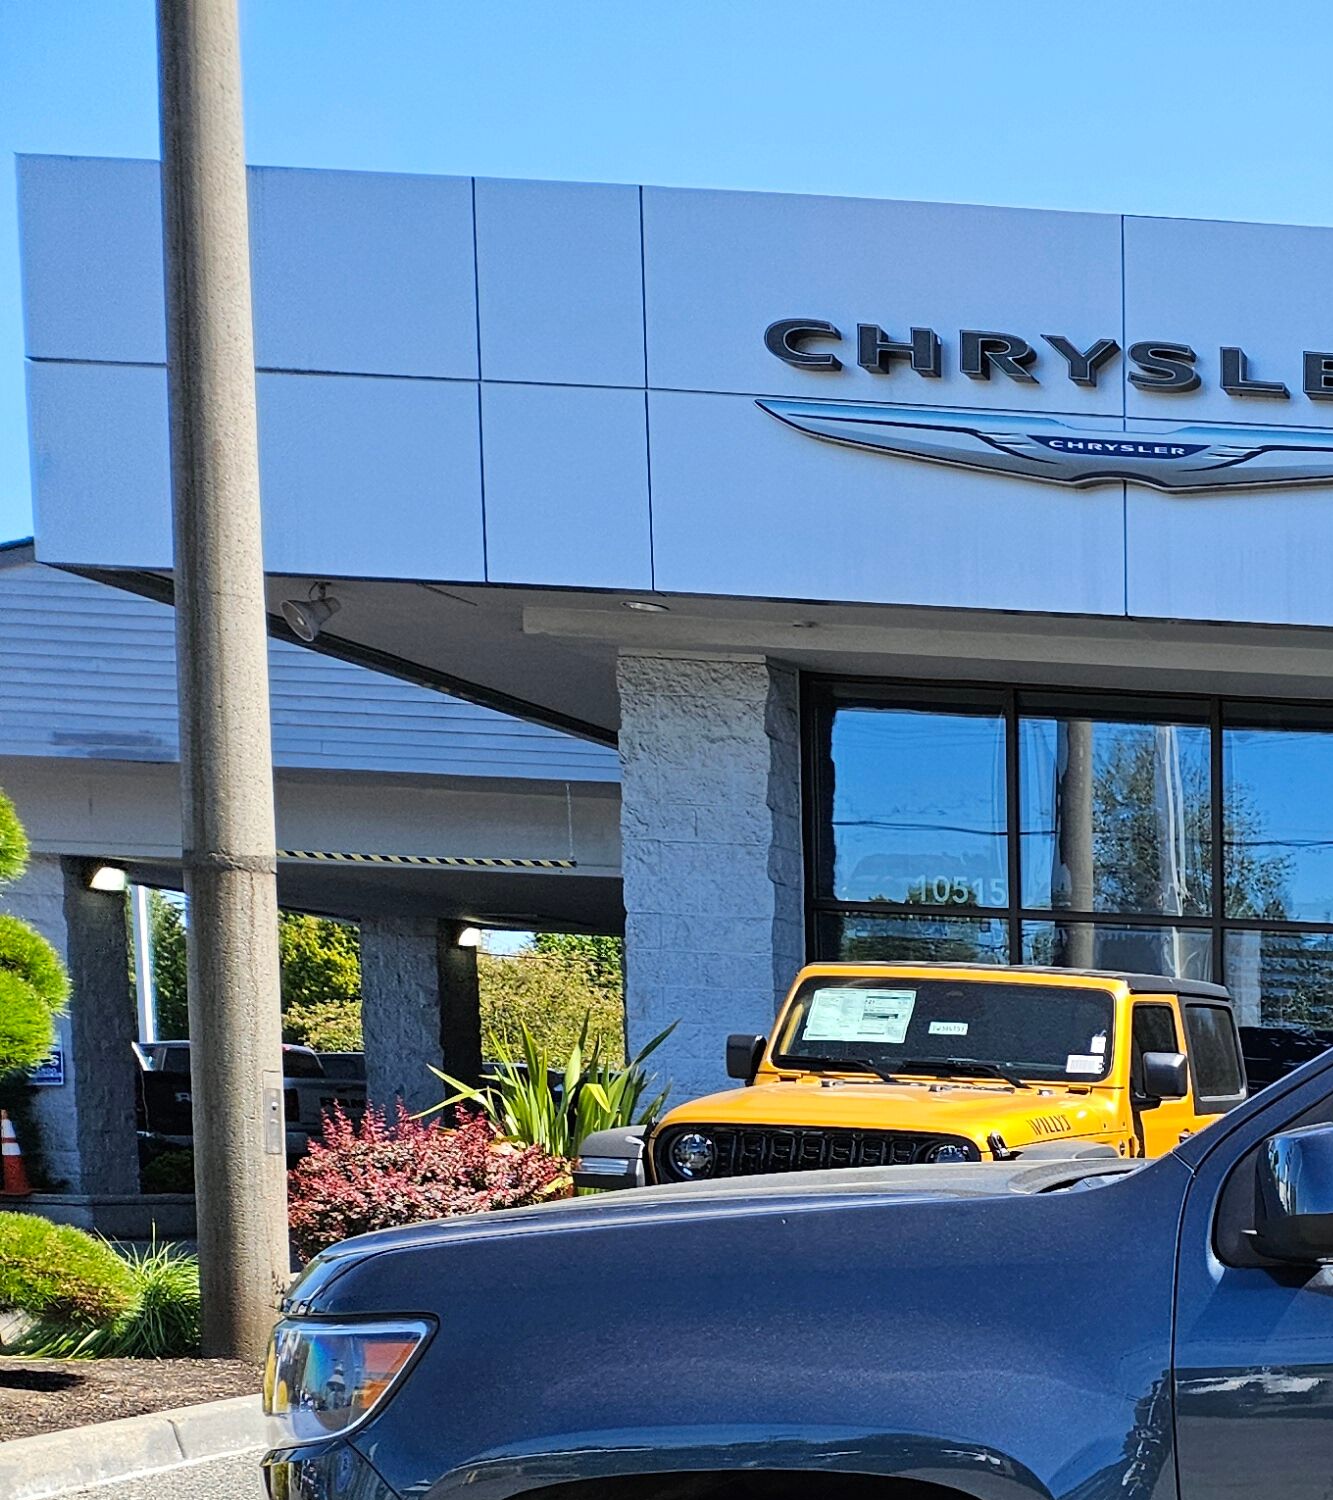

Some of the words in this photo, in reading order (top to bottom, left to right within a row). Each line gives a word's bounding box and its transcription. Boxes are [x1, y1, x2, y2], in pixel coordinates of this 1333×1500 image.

[1049, 438, 1187, 457] CHRYSLER
[914, 874, 1008, 906] 10515
[1025, 1114, 1072, 1136] WILLYS
